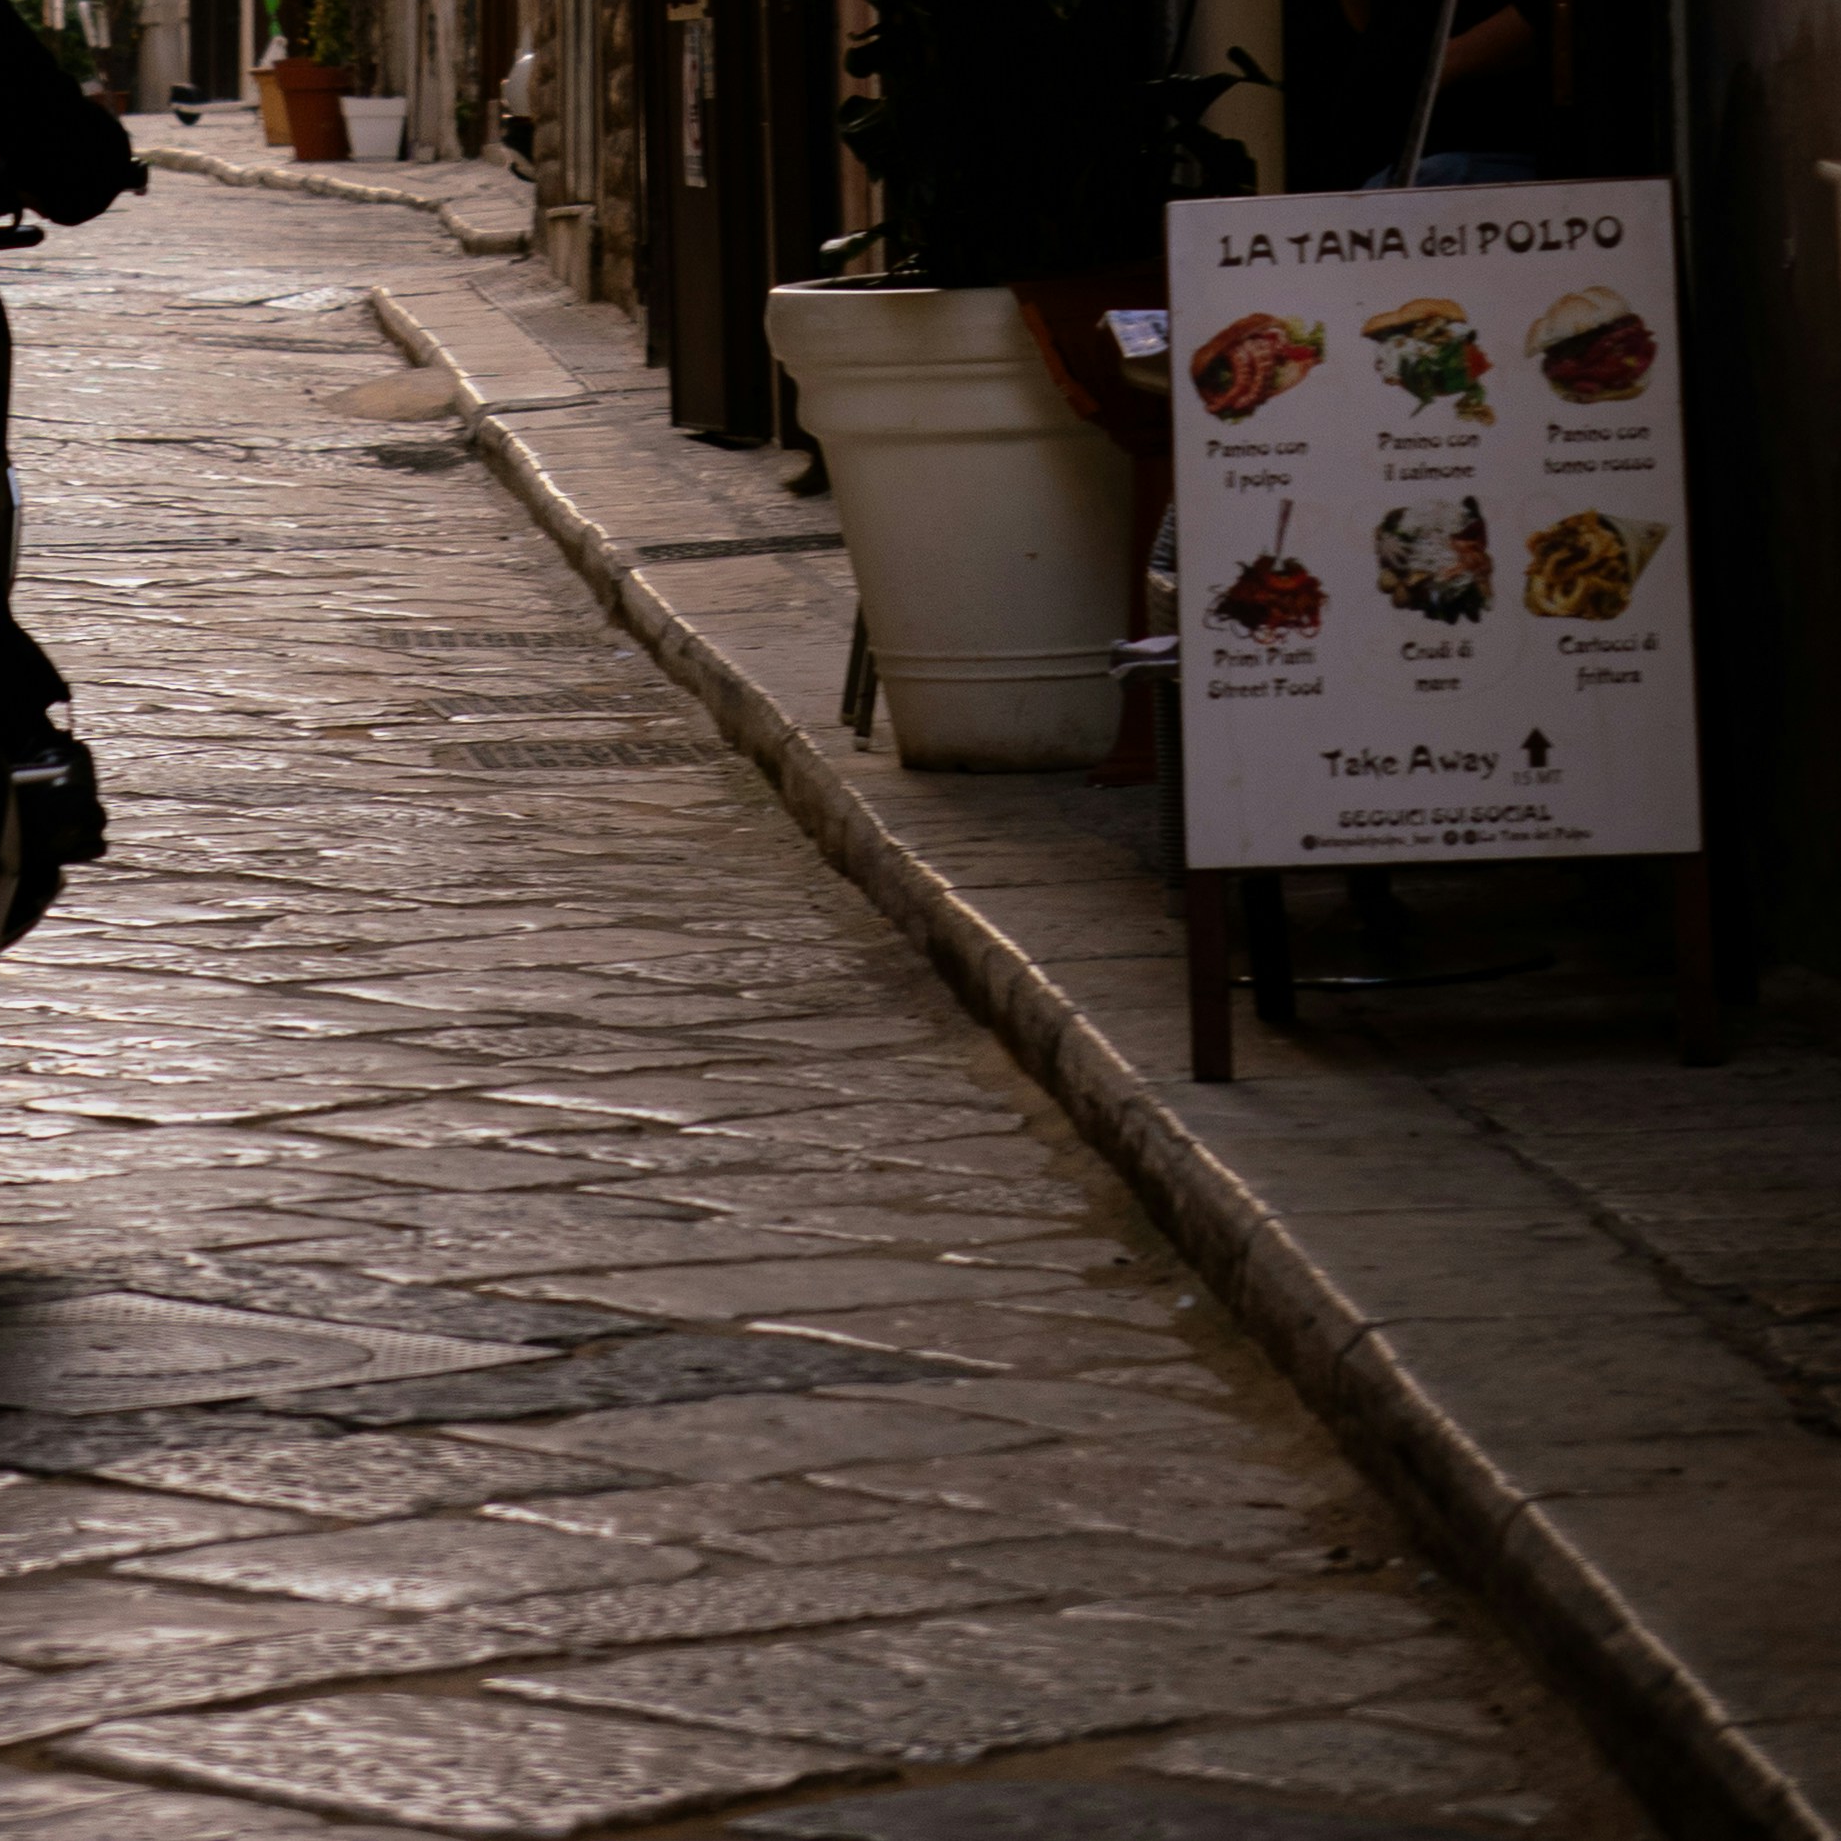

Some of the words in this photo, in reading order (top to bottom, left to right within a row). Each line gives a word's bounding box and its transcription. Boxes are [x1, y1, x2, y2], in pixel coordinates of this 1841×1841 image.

[1219, 233, 1279, 268] LA
[1286, 226, 1409, 264] TANA
[1419, 223, 1468, 259] del
[1477, 215, 1625, 257] POLPO
[1377, 431, 1441, 451] Panino
[1445, 431, 1481, 449] con
[1546, 423, 1611, 442] Panino
[1615, 424, 1651, 440] con
[1206, 439, 1271, 459] Panino
[1274, 440, 1310, 456] con
[1240, 469, 1293, 494] polpo
[1399, 462, 1476, 481] salmone
[1400, 640, 1451, 662] Crudi
[1457, 640, 1474, 659] di
[1557, 634, 1638, 657] Cartocci
[1642, 632, 1660, 651] di
[1207, 679, 1270, 699] Street
[1274, 676, 1324, 697] Food
[1414, 676, 1462, 692] mare
[1576, 667, 1642, 692] frittura
[1320, 746, 1401, 781] Take
[1406, 743, 1500, 780] Away
[1338, 808, 1427, 828] SEGUICI
[1470, 803, 1553, 824] SOCIAL
